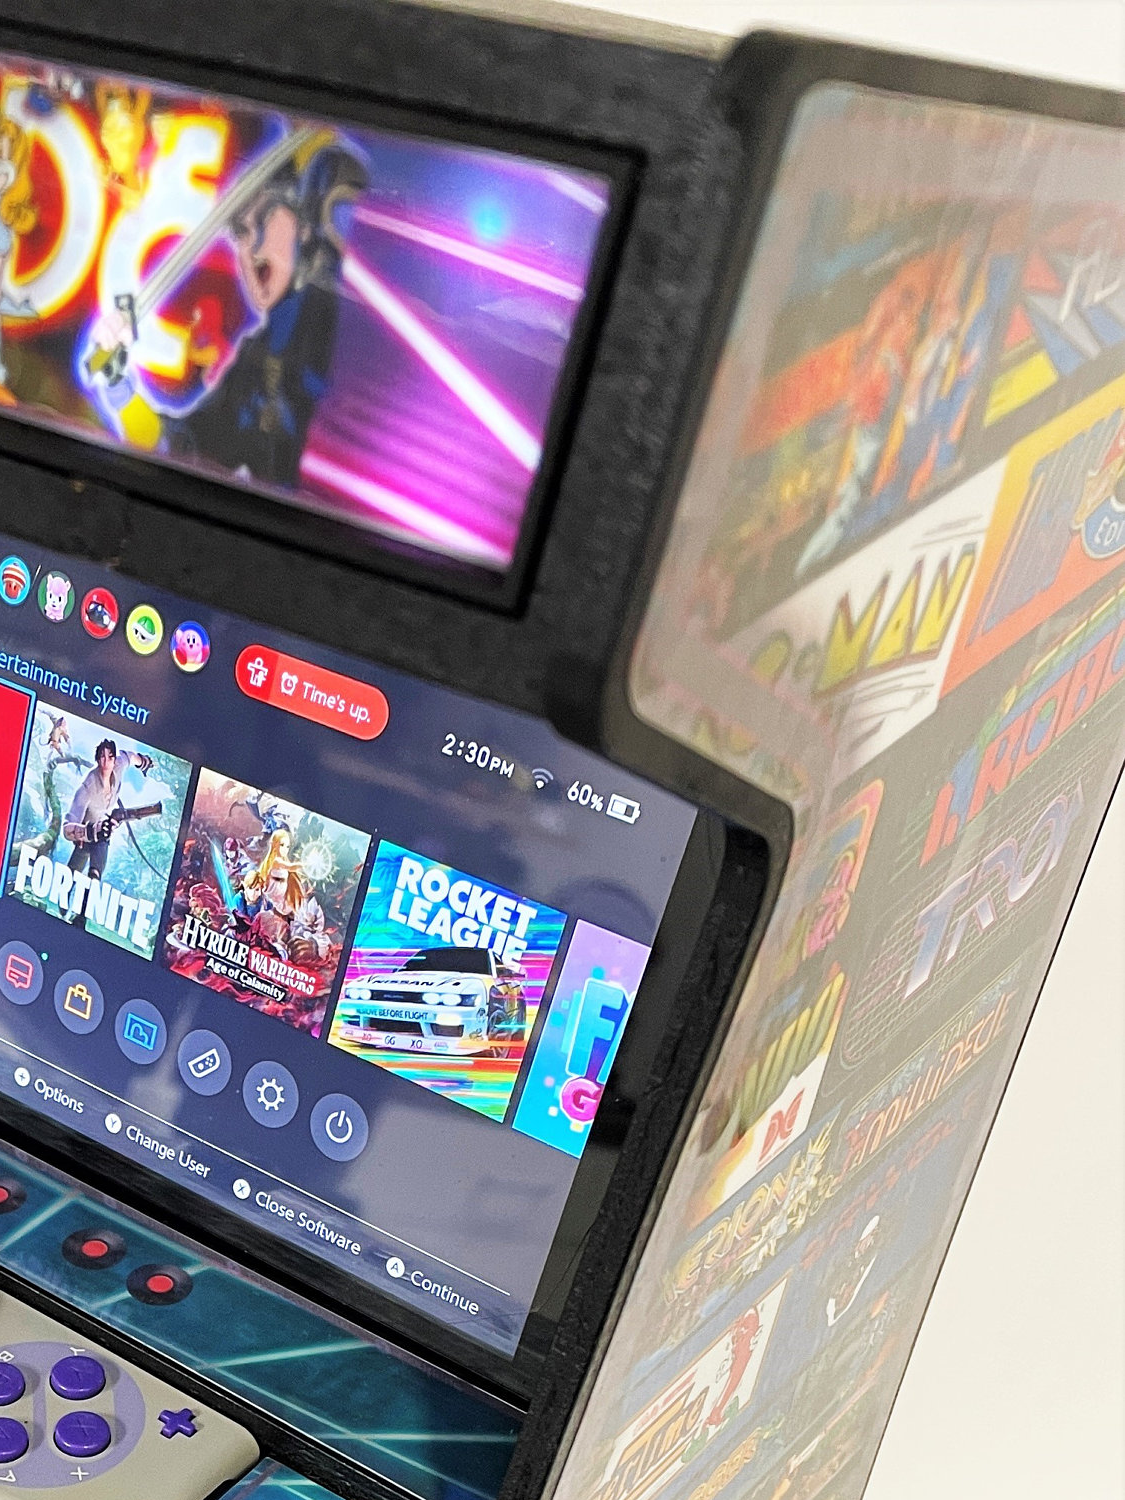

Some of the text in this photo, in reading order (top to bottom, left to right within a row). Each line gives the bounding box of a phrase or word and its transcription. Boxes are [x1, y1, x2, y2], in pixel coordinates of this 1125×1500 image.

[302, 680, 371, 724] Time's up.
[567, 780, 605, 812] 60%
[13, 843, 156, 950] FORTNITE
[396, 856, 538, 939] ROCKET
[181, 913, 316, 996] HYRULE WARRIORS
[387, 888, 528, 976] LEAGUE
[206, 957, 286, 1002] Age of Calamity
[34, 1078, 84, 1114] Options
[126, 1125, 176, 1161] Change
[178, 1150, 211, 1179] User
[255, 1191, 295, 1222] Close
[297, 1212, 362, 1256] Software
[410, 1270, 480, 1315] Continue
